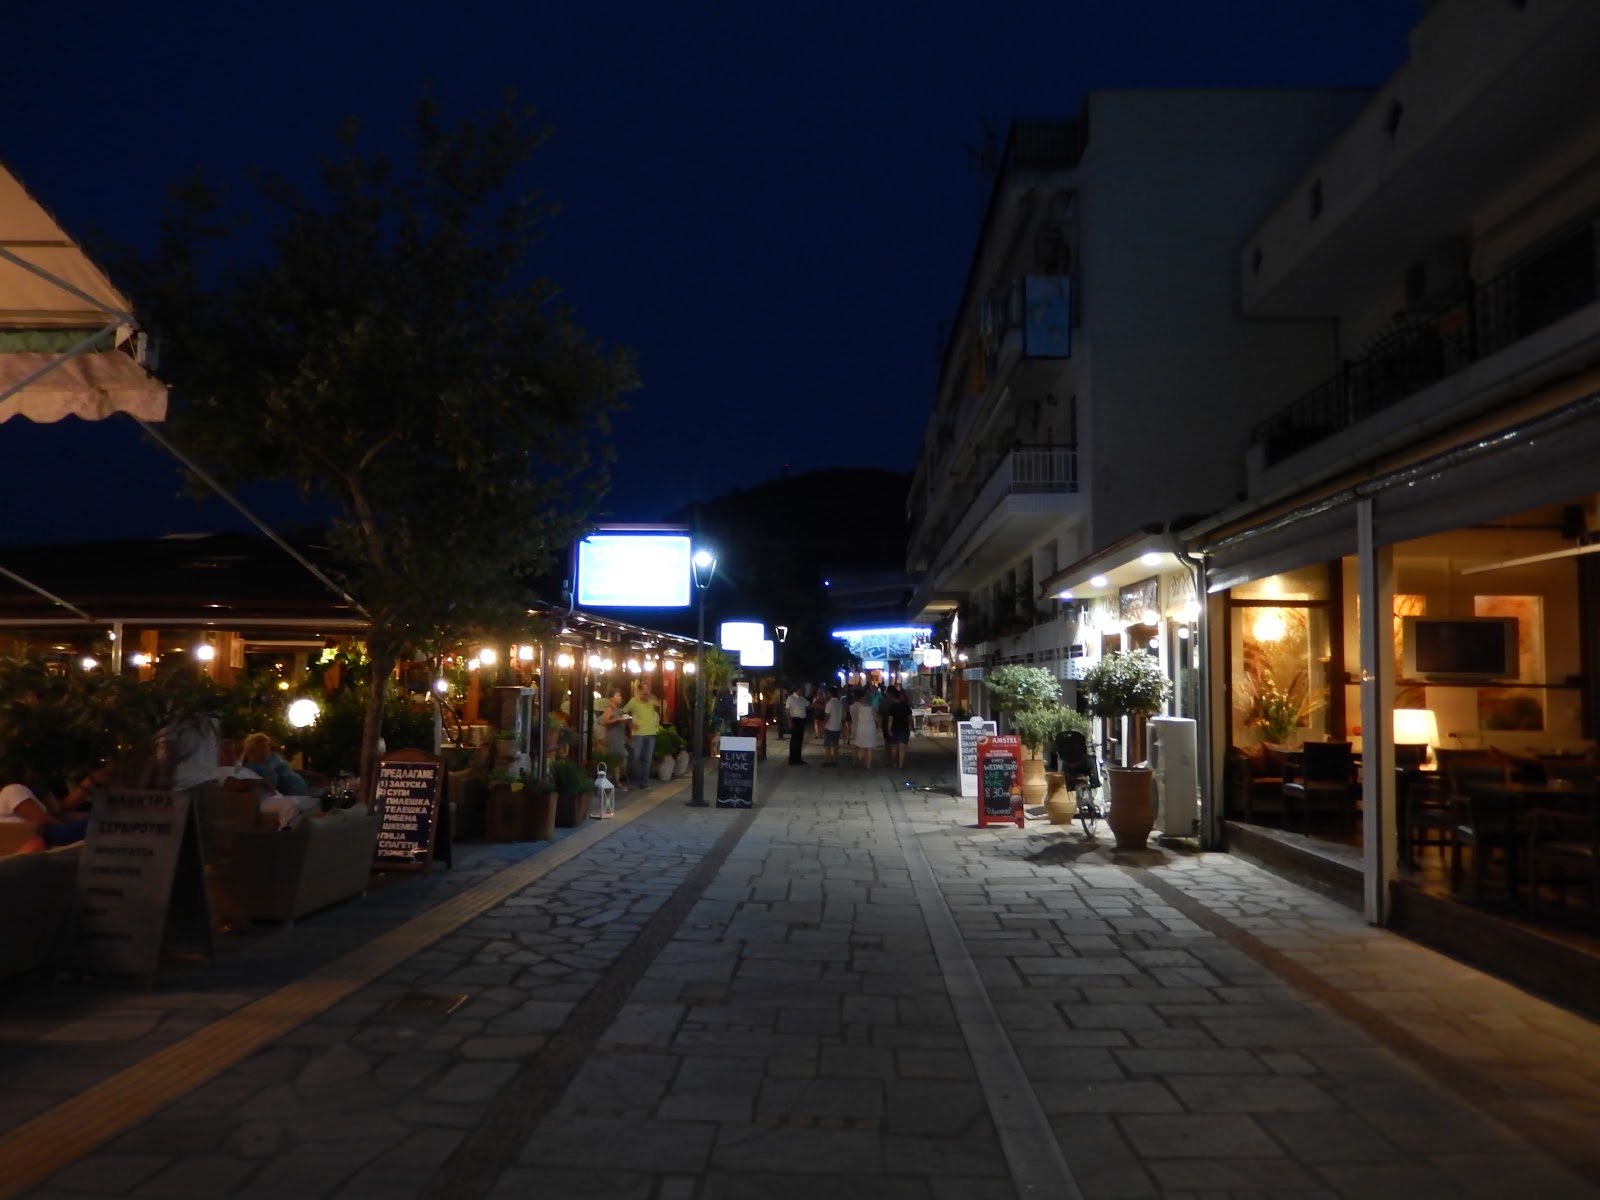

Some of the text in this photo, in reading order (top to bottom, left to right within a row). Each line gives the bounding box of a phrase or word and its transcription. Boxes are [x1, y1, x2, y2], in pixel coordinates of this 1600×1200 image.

[725, 752, 748, 761] LIVE
[720, 761, 749, 771] MUSIC
[380, 768, 434, 779] ПРЕДЛАГАМЕ
[389, 780, 428, 789] ЗАКУСКА
[387, 788, 411, 797] СУПИ
[386, 797, 430, 806] ПИЛЕШКА
[384, 805, 428, 814] ТЕЛЕШКА
[383, 814, 418, 822] РИБЕНА
[379, 840, 419, 849] СПАГЕТИ
